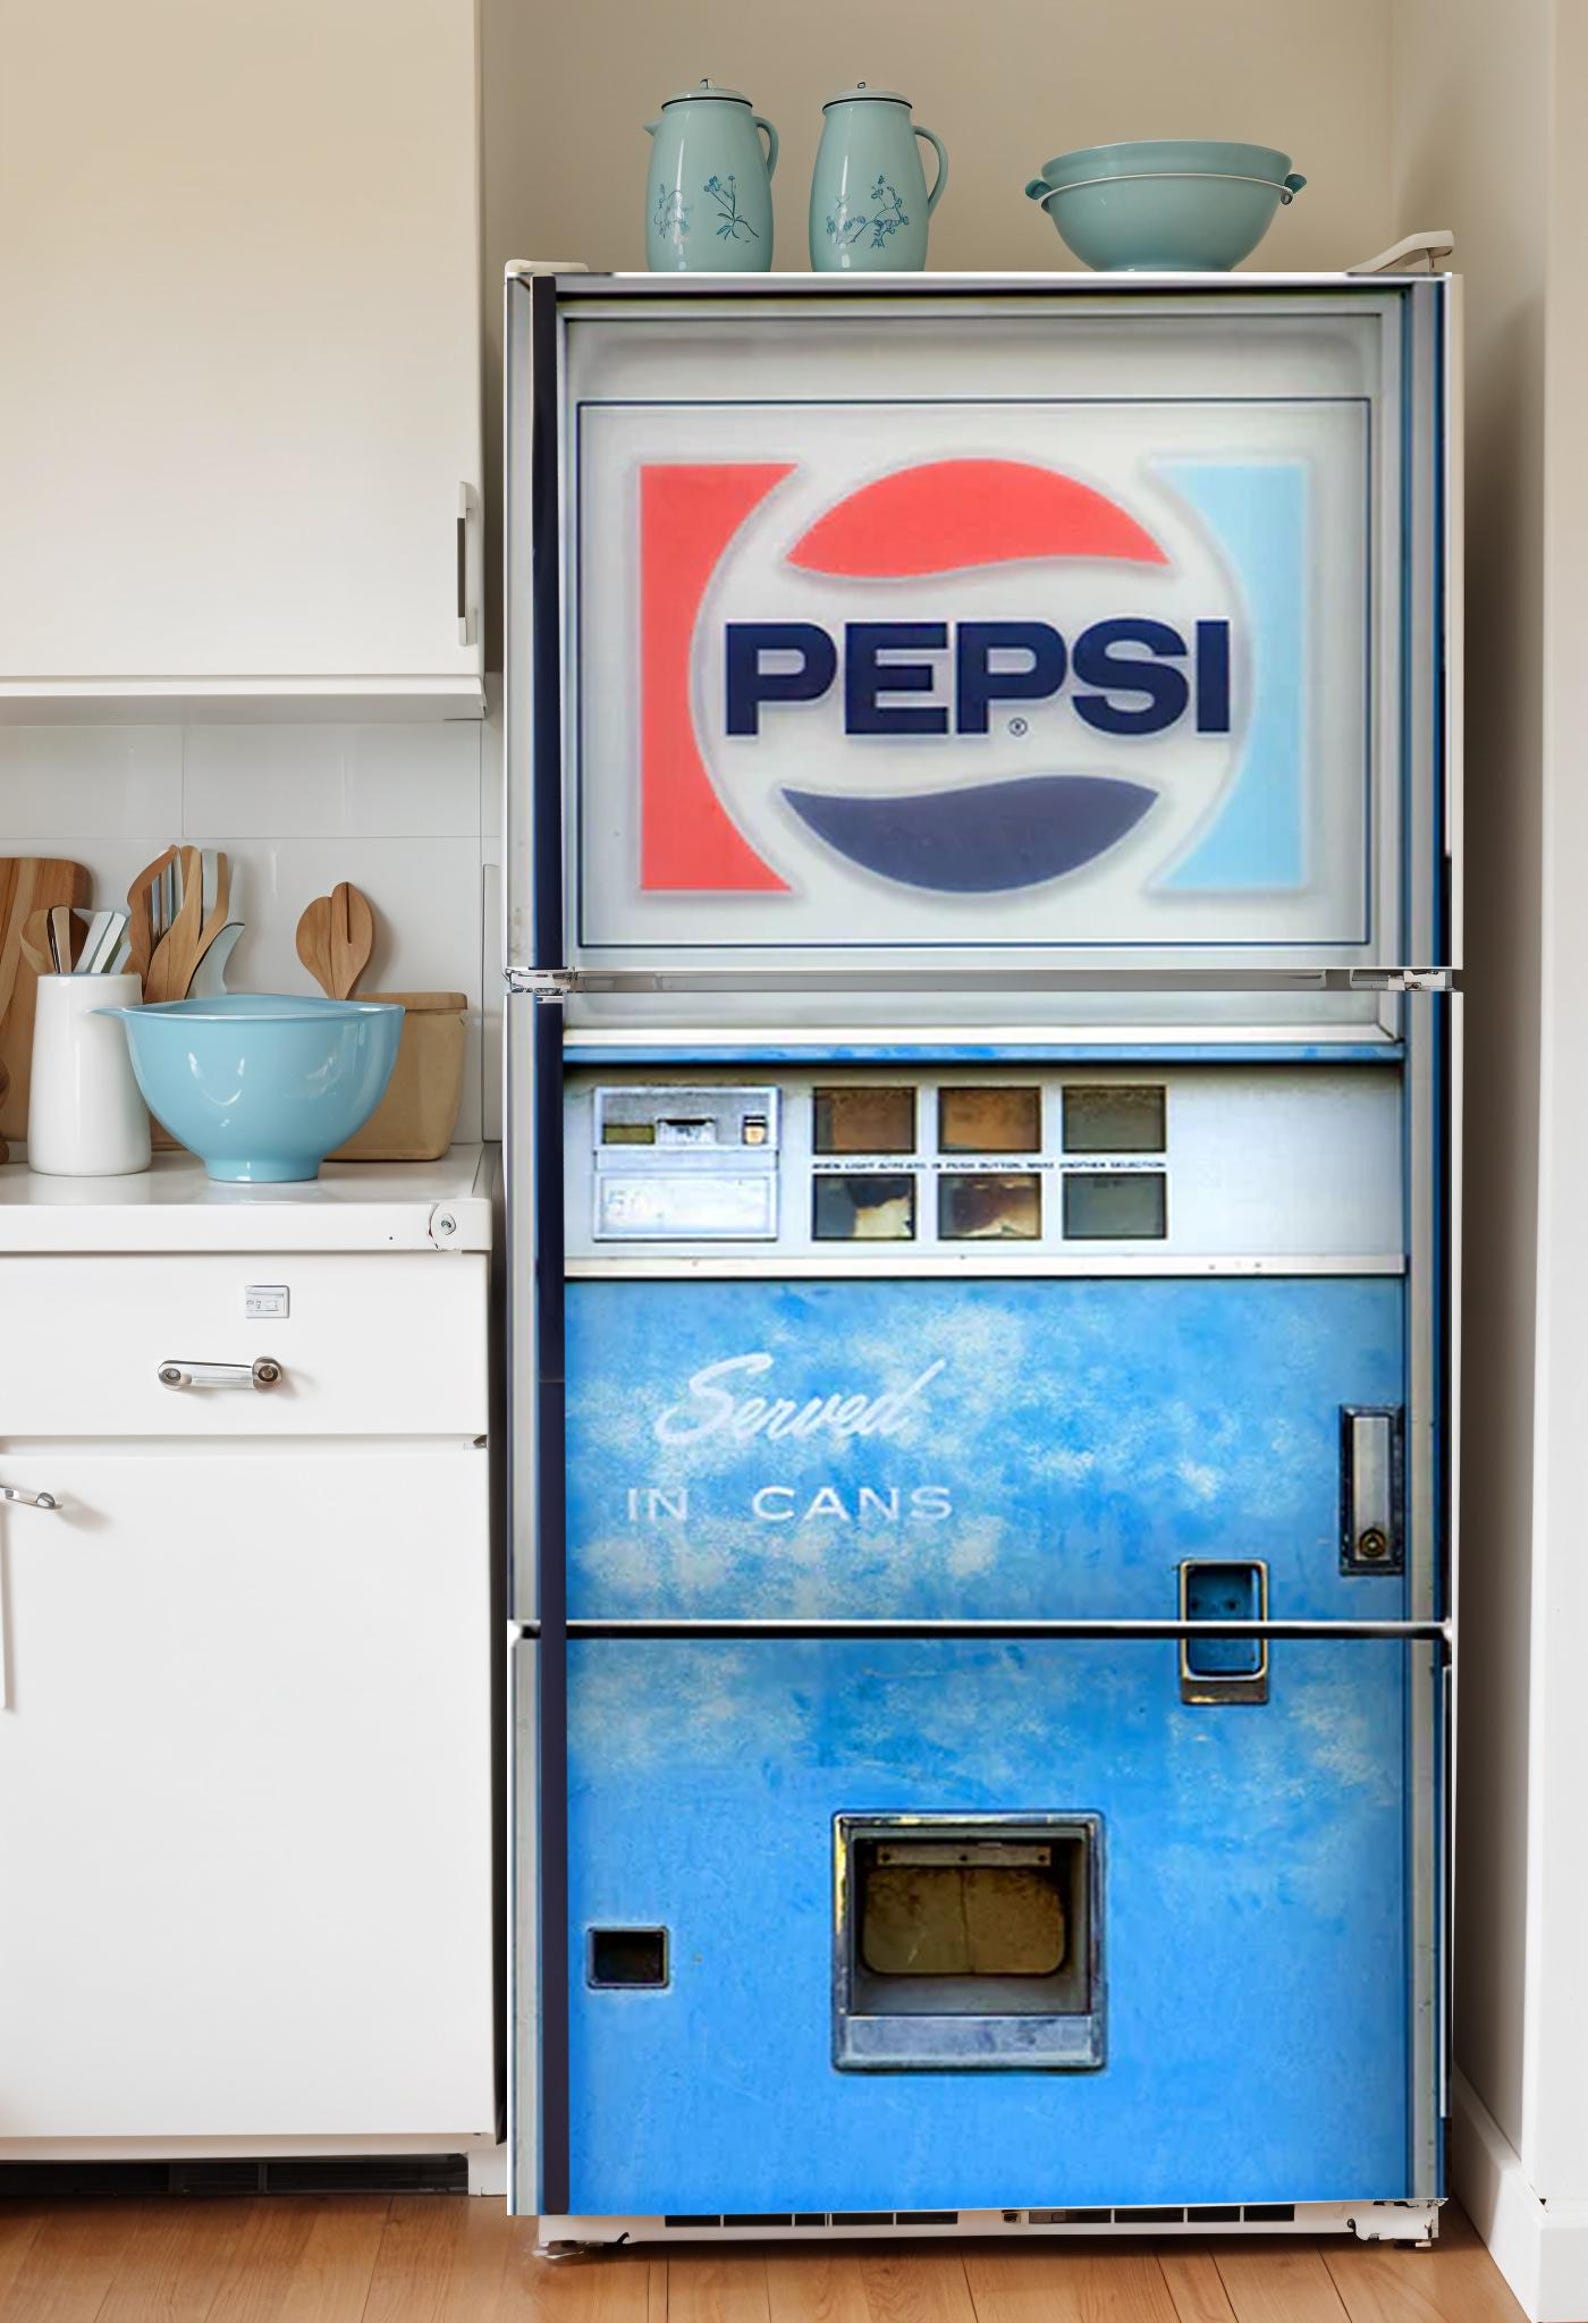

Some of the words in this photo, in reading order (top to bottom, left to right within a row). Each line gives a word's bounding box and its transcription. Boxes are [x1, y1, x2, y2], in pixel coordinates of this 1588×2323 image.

[725, 617, 1230, 736] PEPSI
[655, 1353, 946, 1442] Served
[627, 1488, 688, 1521] IN
[753, 1486, 952, 1521] CANS
